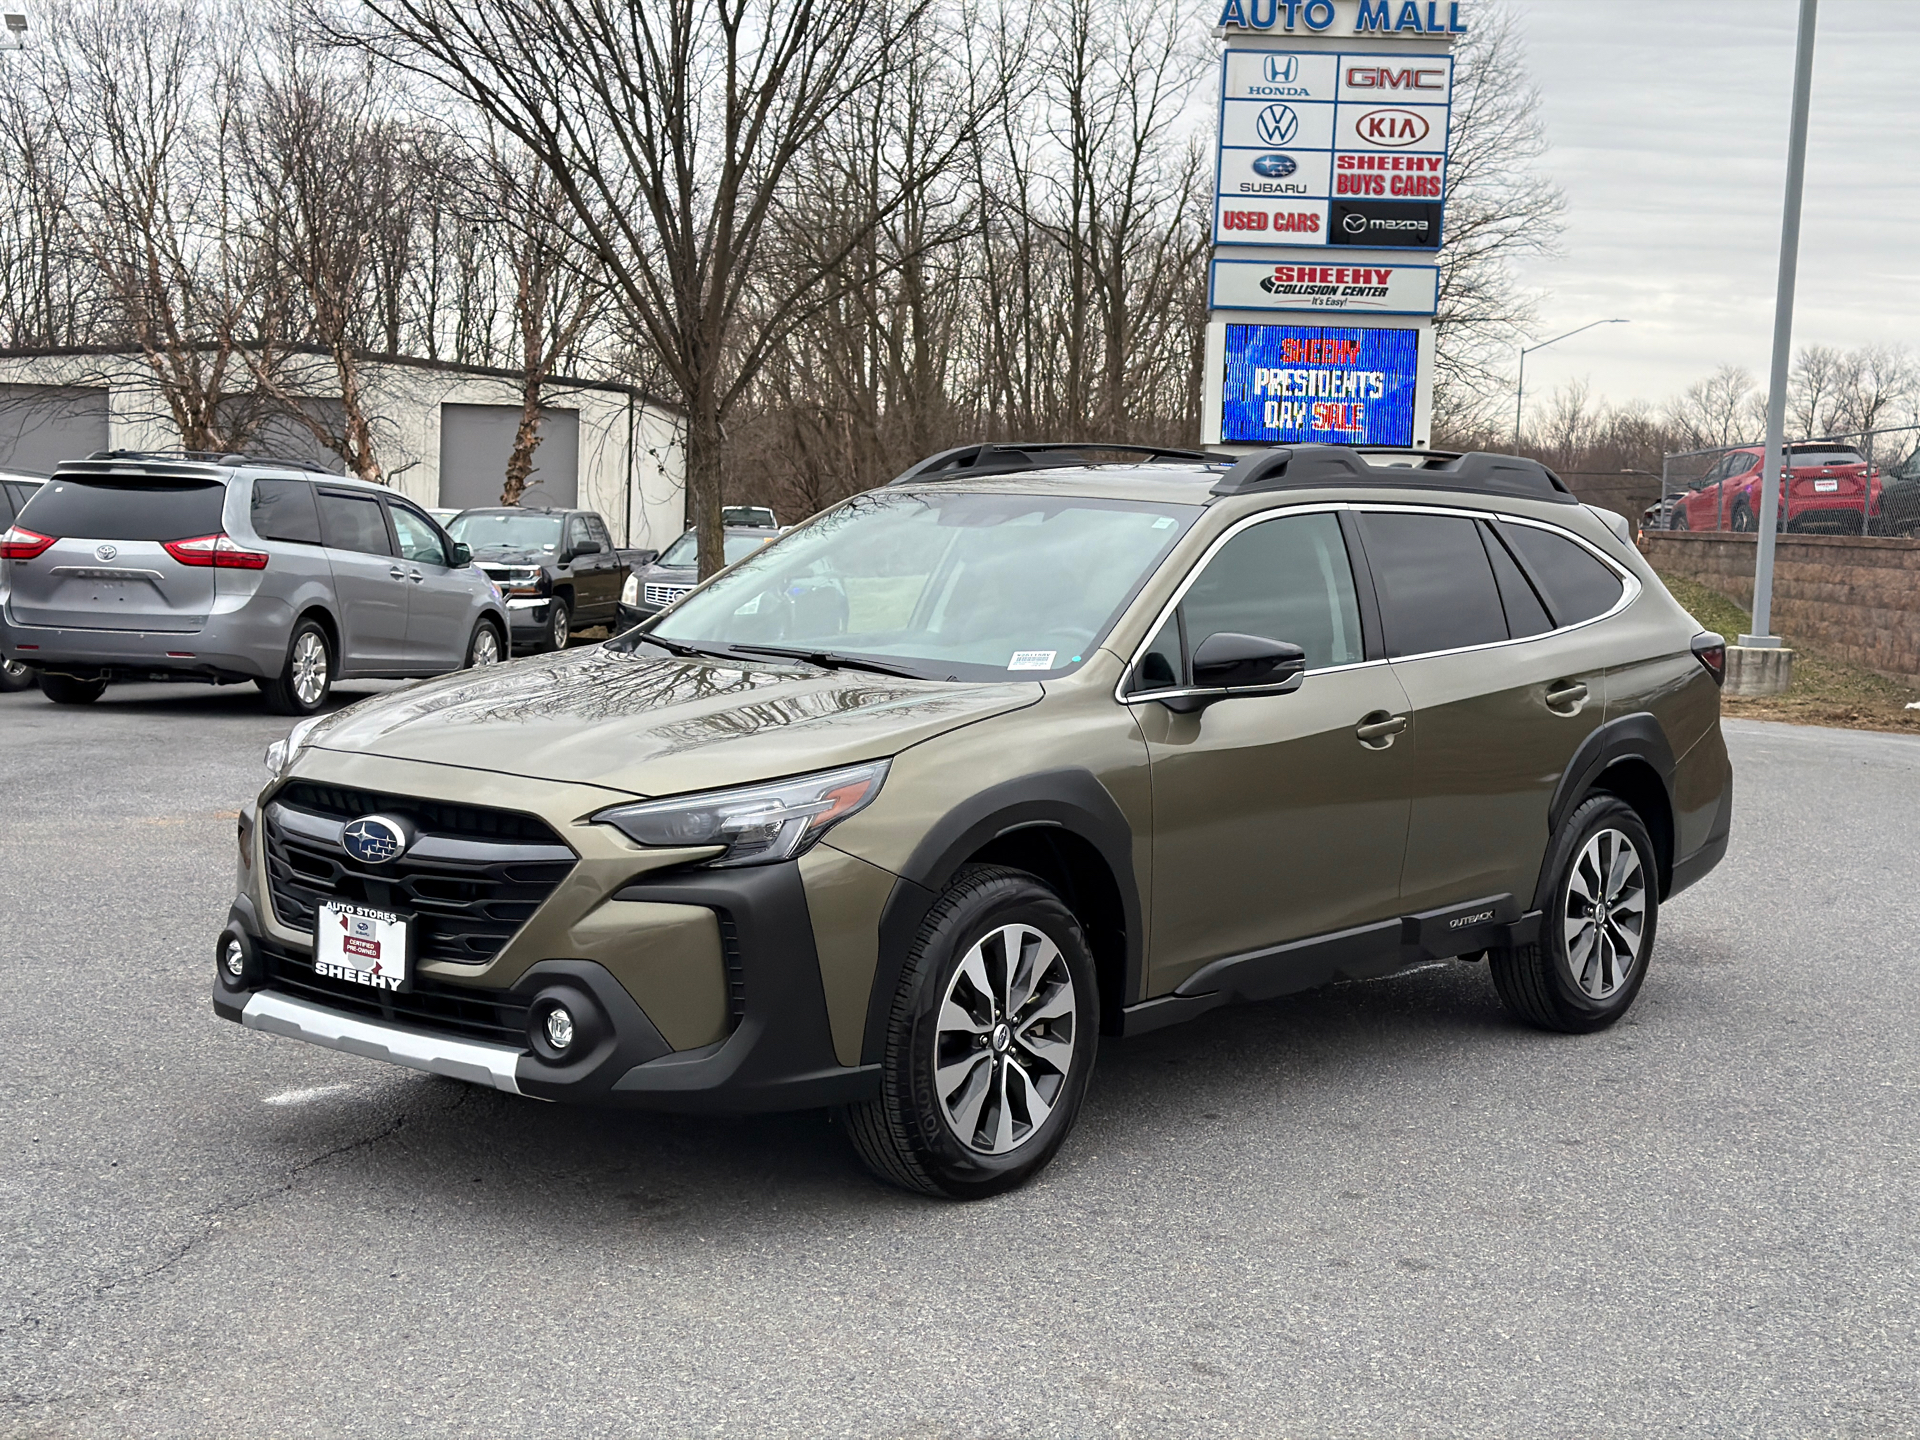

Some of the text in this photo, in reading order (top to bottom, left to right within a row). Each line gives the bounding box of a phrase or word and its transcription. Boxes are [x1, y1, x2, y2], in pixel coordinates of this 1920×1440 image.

[1219, 0, 1467, 34] AUTO MALL
[1346, 66, 1444, 91] GMC
[1248, 86, 1311, 97] HONDA
[1369, 118, 1416, 138] KIA
[1337, 156, 1442, 171] SHEEHY
[1240, 182, 1307, 194] SUBARU
[1337, 174, 1442, 197] BUYS CARS
[1223, 211, 1320, 233] USED CARS
[1274, 266, 1393, 285] SHEEHY
[1274, 284, 1389, 297] COLLISION CENTER
[1311, 297, 1347, 307] It's Easy!
[1281, 338, 1360, 364] SHEEHY
[1254, 367, 1383, 398] PRESIDENTS
[1264, 401, 1363, 431] DAY SALE
[326, 901, 397, 922] AUTO STORES
[1449, 911, 1493, 928] OUTBACK
[346, 944, 377, 956] PRE-OWNED
[349, 939, 375, 949] CERTIFIED
[315, 962, 402, 992] SHEEHY
